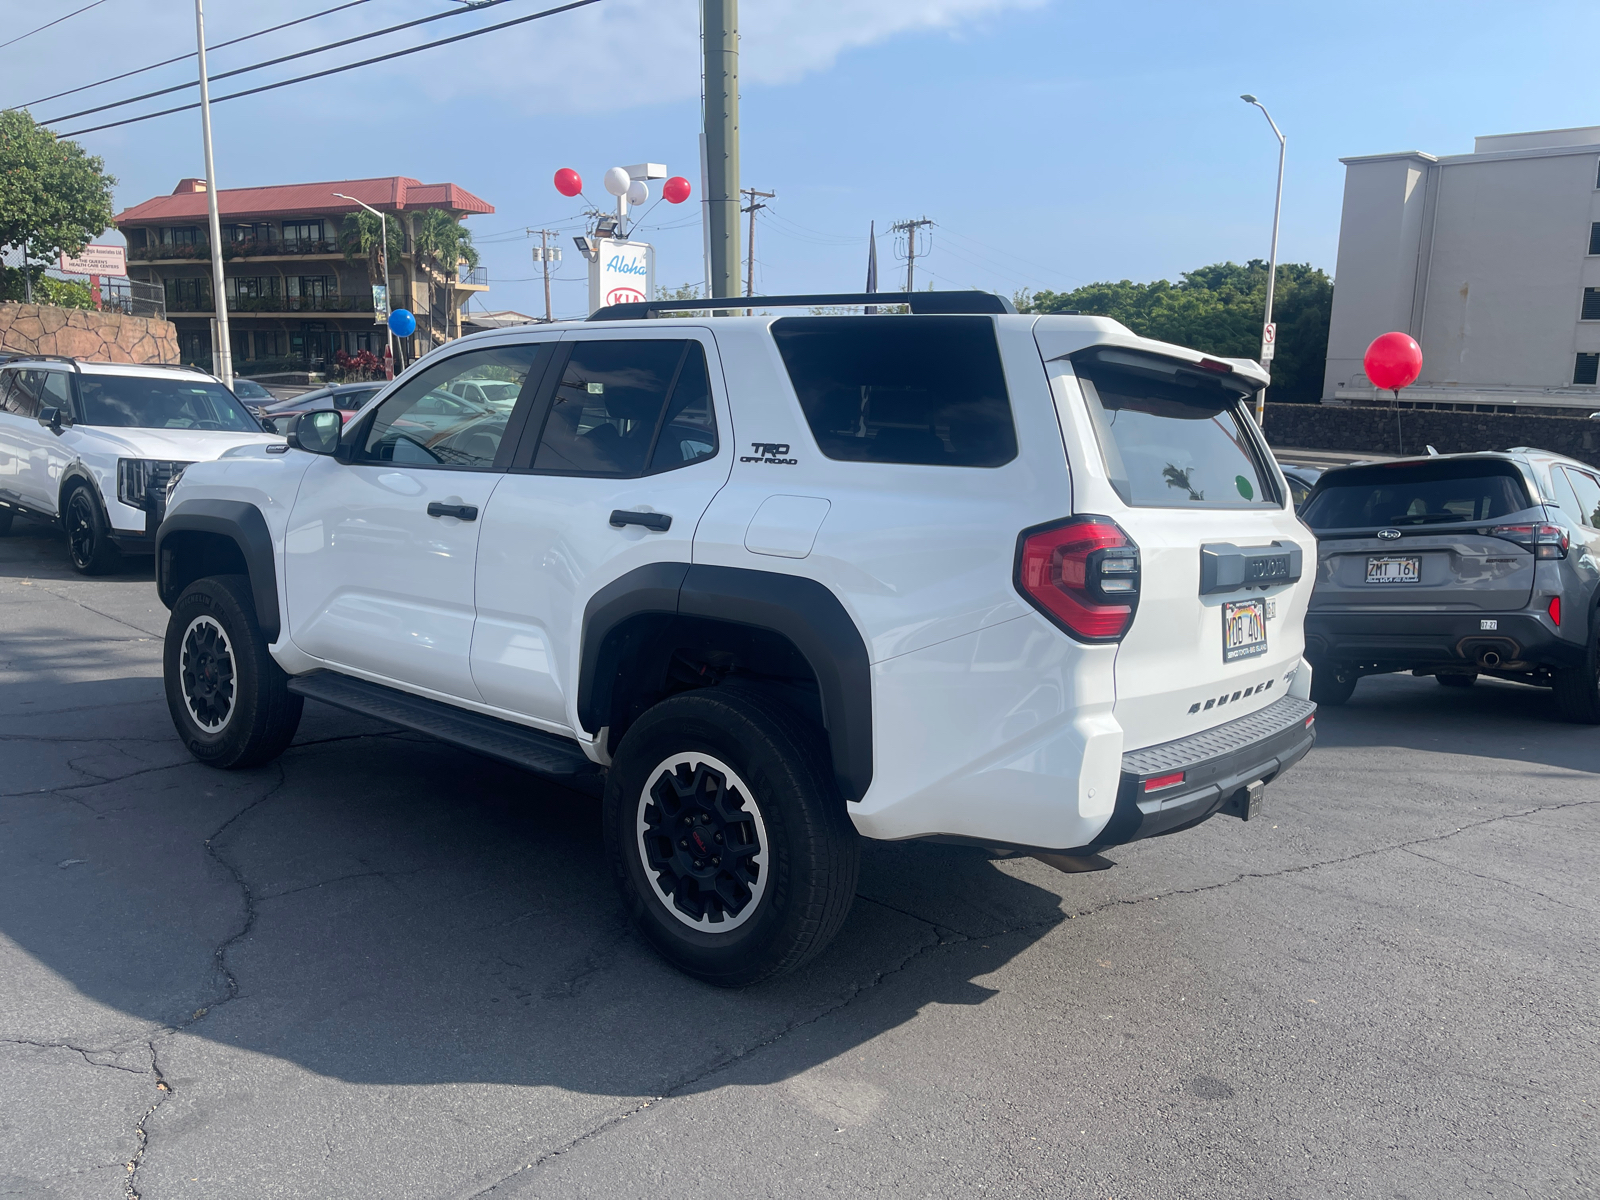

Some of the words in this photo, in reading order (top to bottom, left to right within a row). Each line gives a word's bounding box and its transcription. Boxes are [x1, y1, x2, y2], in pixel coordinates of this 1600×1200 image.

[606, 255, 647, 275] Aloha
[614, 293, 639, 304] KIA
[751, 443, 790, 458] TRD
[764, 457, 798, 465] ROAD
[1252, 557, 1287, 577] TOYOTA
[1368, 563, 1390, 577] ZMT
[1397, 562, 1416, 576] 161
[1226, 615, 1244, 648] YDB
